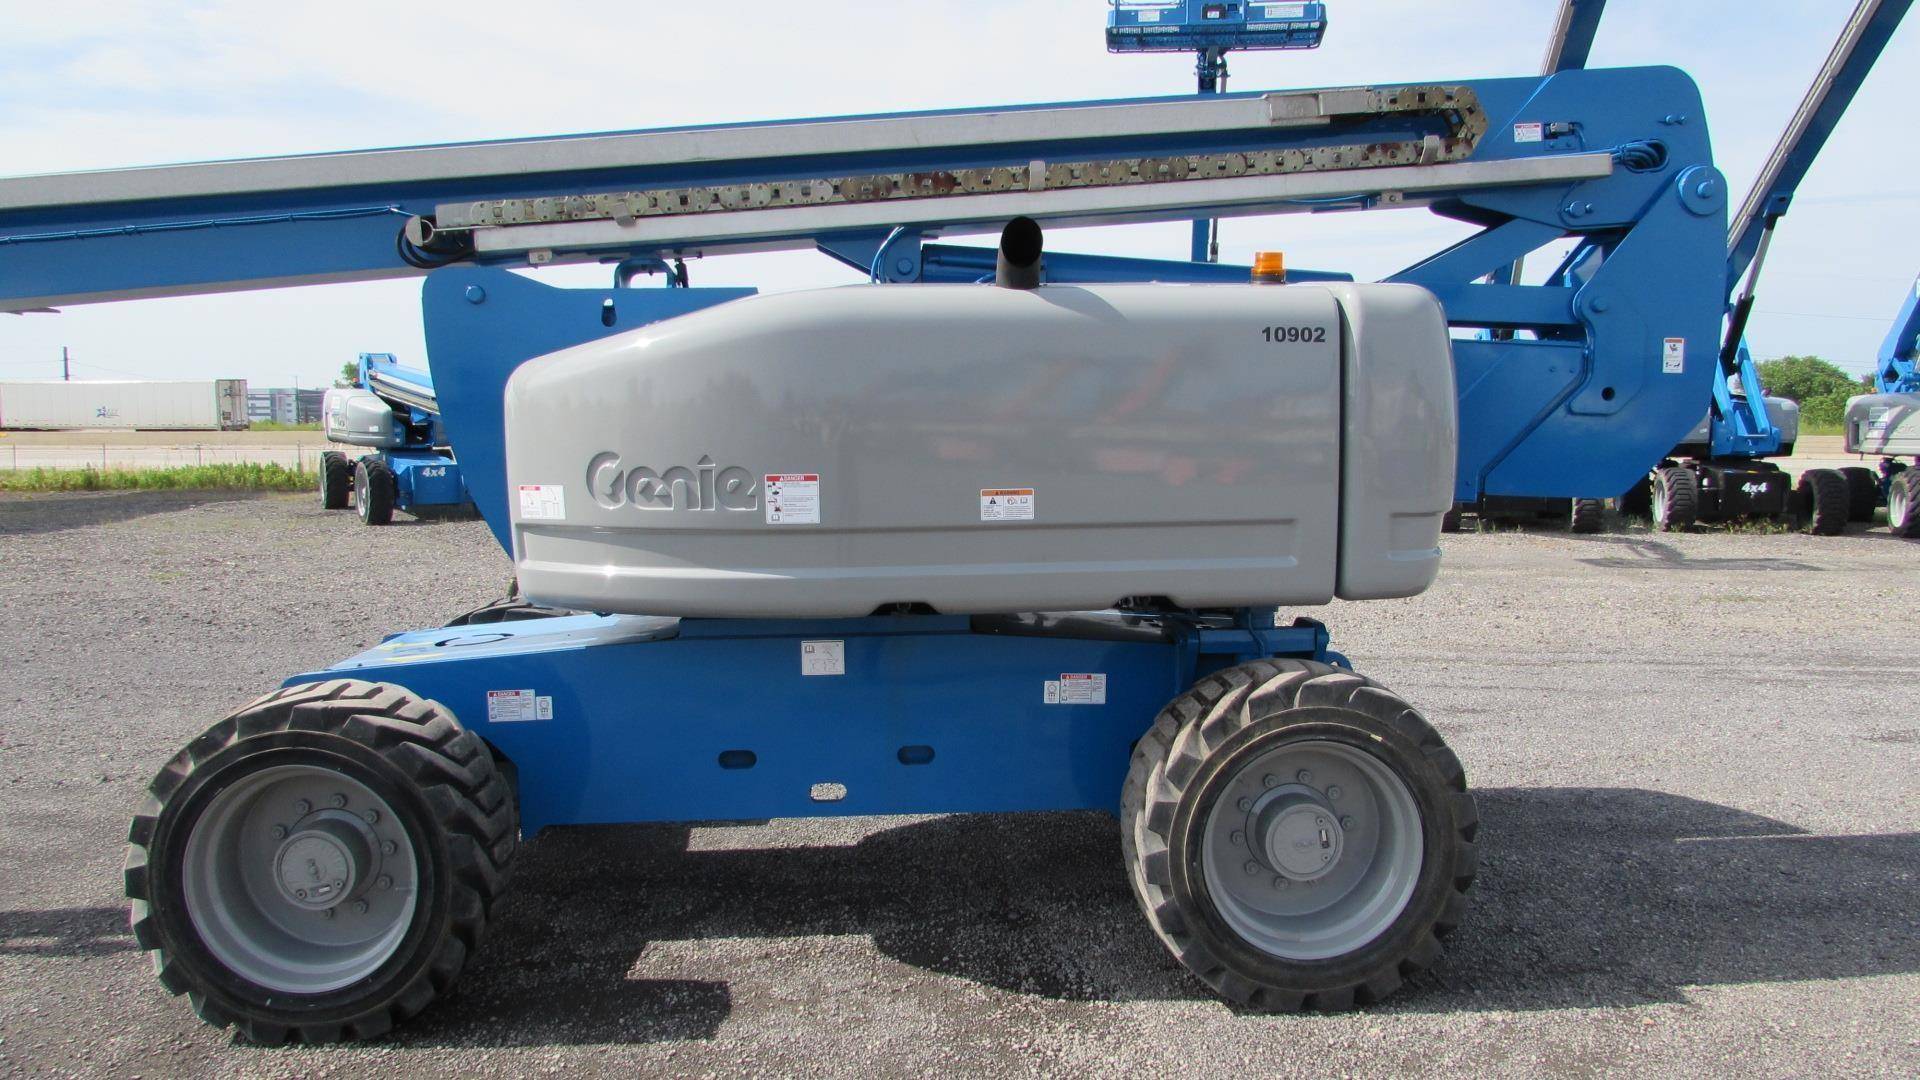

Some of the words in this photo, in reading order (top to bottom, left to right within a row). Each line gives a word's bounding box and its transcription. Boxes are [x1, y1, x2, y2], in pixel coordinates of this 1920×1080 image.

[1262, 327, 1326, 343] 10902
[422, 466, 446, 477] 4x4
[586, 451, 757, 511] Genie
[1741, 482, 1767, 493] 4x4
